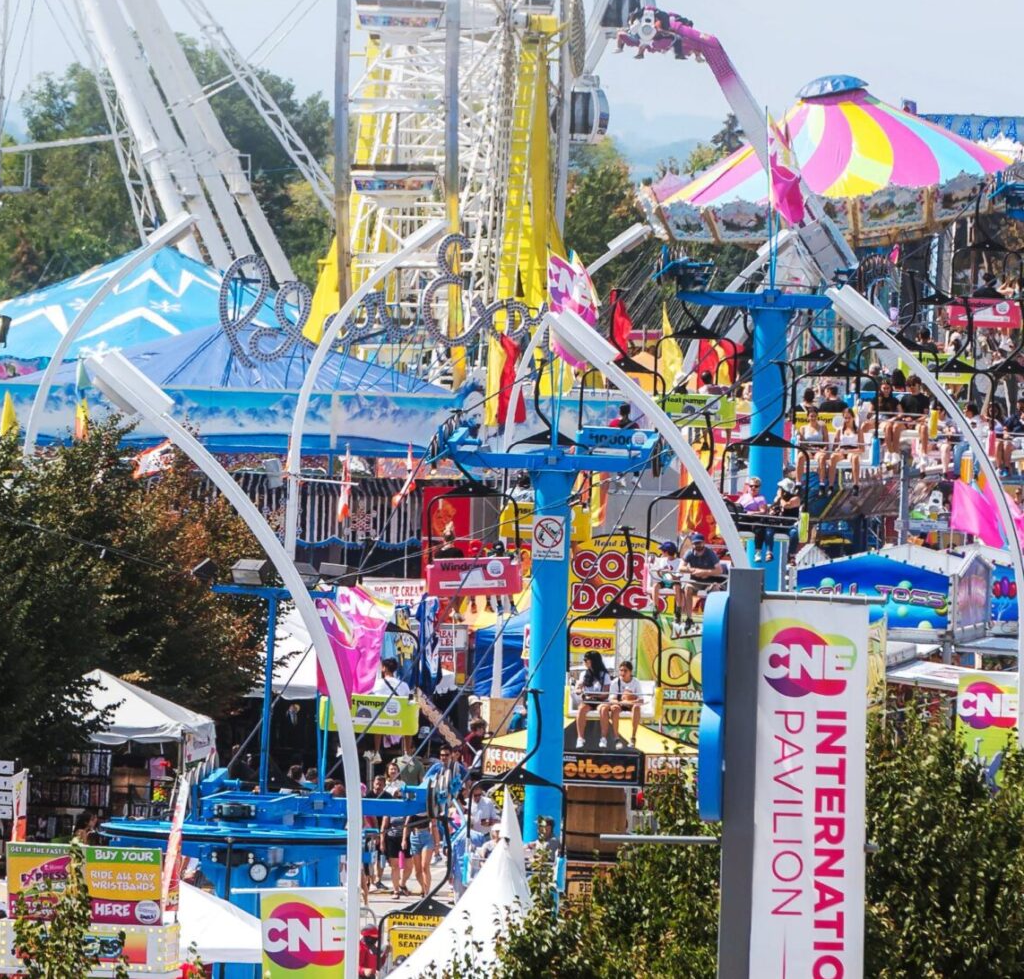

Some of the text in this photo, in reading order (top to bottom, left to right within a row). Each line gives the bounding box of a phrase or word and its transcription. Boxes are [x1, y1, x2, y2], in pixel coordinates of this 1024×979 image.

[572, 550, 647, 582] COR
[874, 584, 946, 609] TOSS
[571, 637, 612, 649] CORN
[763, 642, 855, 680] CNE
[957, 691, 1018, 718] CNE
[487, 748, 501, 760] ICE
[486, 762, 512, 773] Rootb
[563, 758, 636, 780] otbeer
[771, 710, 804, 916] PAVILION
[94, 849, 154, 862] BUY YOUR
[91, 870, 113, 878] RIDE
[135, 872, 156, 881] DAY
[94, 902, 131, 917] HERE
[422, 914, 440, 922] SPIT
[262, 917, 346, 953] CNE
